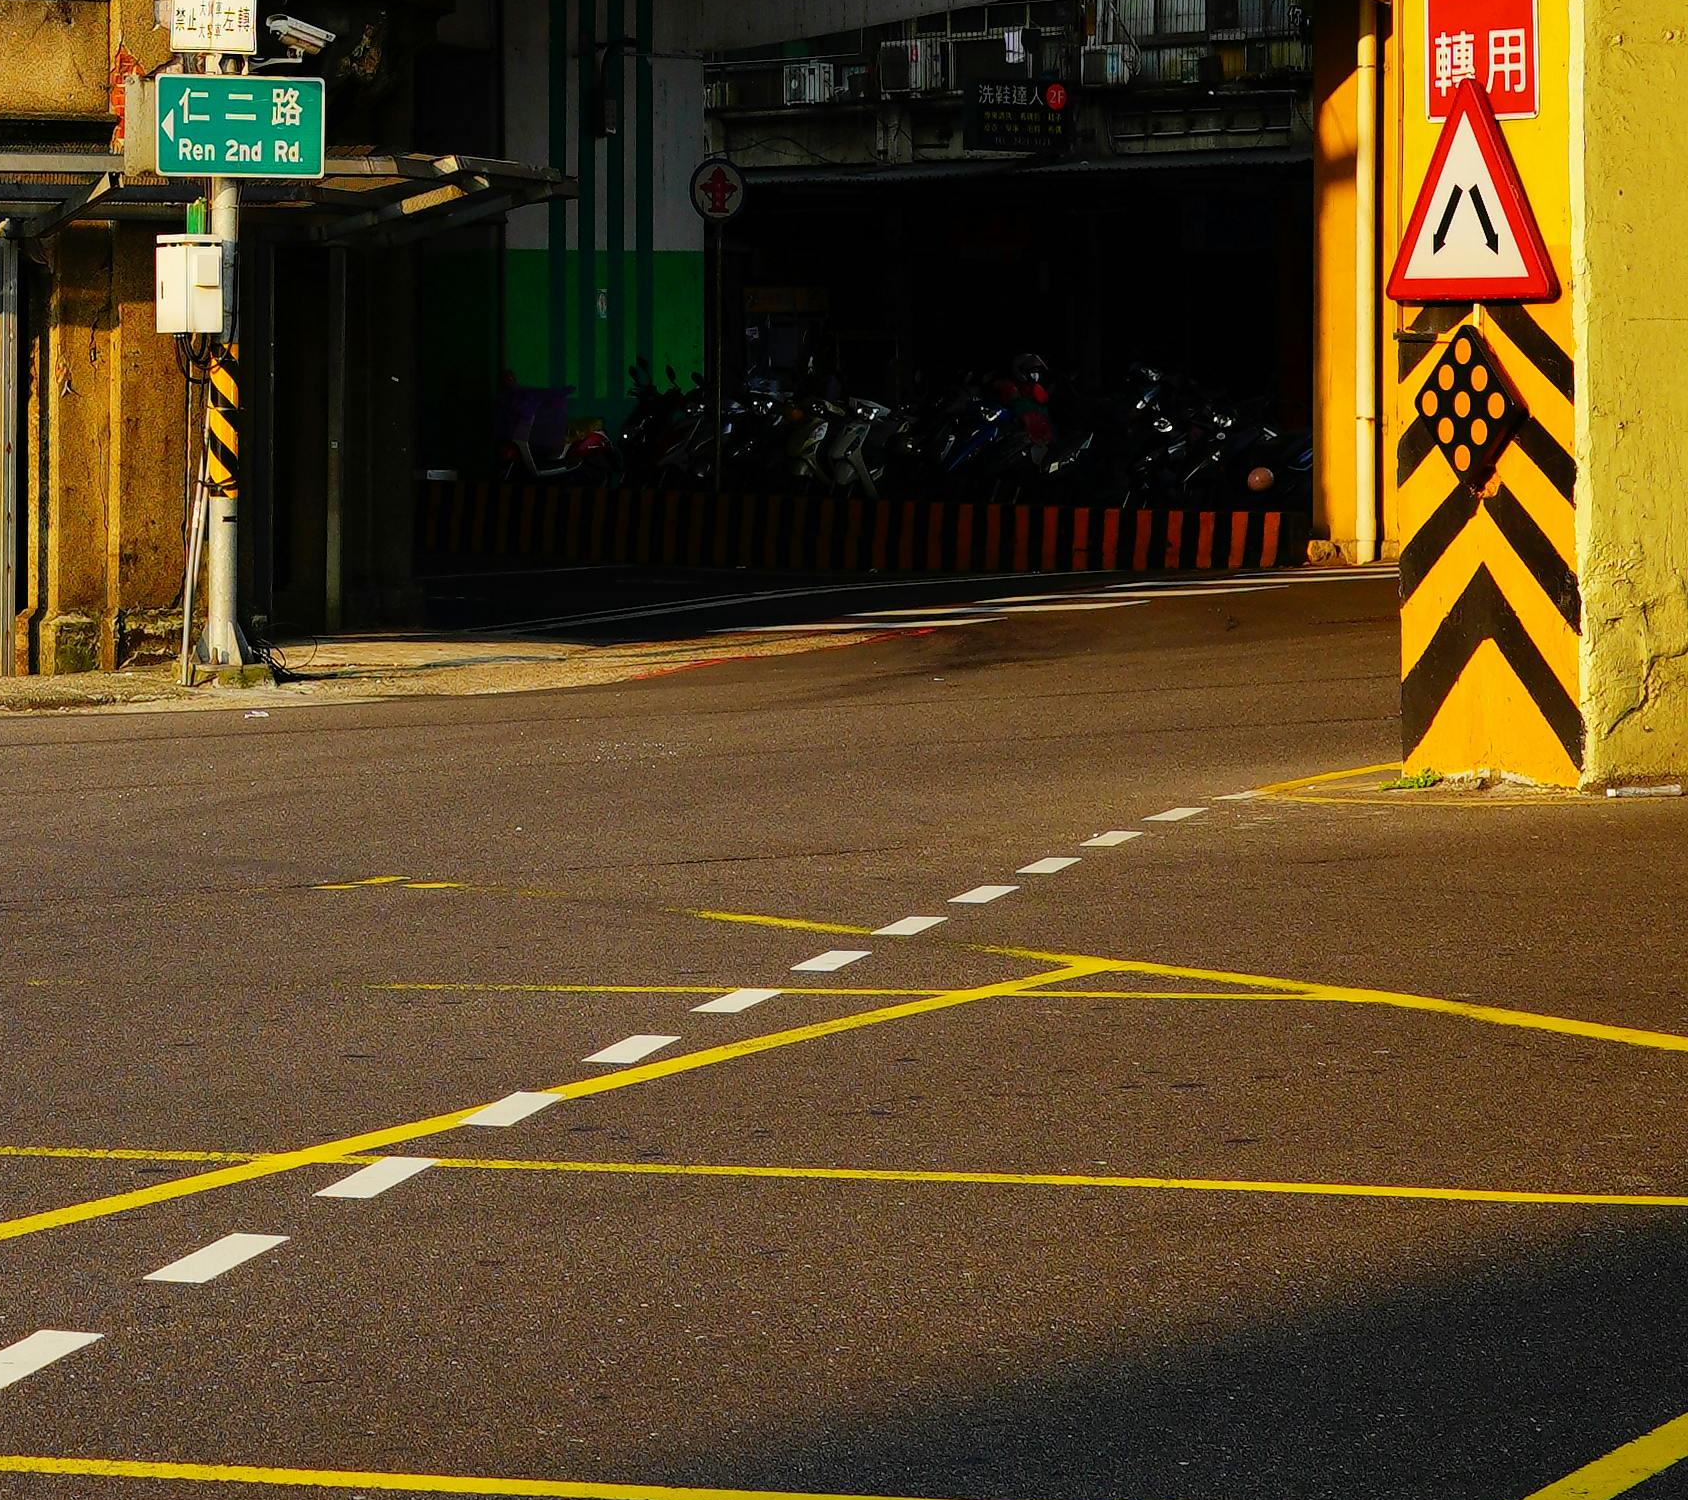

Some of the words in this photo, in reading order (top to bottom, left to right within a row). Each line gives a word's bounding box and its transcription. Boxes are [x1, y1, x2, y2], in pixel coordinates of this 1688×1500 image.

[175, 7, 197, 31] 禁止
[223, 6, 250, 32] 左轉
[179, 87, 303, 126] 仁二路
[978, 84, 1045, 106] 洗鞋達人
[1049, 90, 1064, 104] 2F
[179, 138, 215, 161] Ren
[225, 139, 262, 162] 2nd
[274, 140, 303, 163] Rd.
